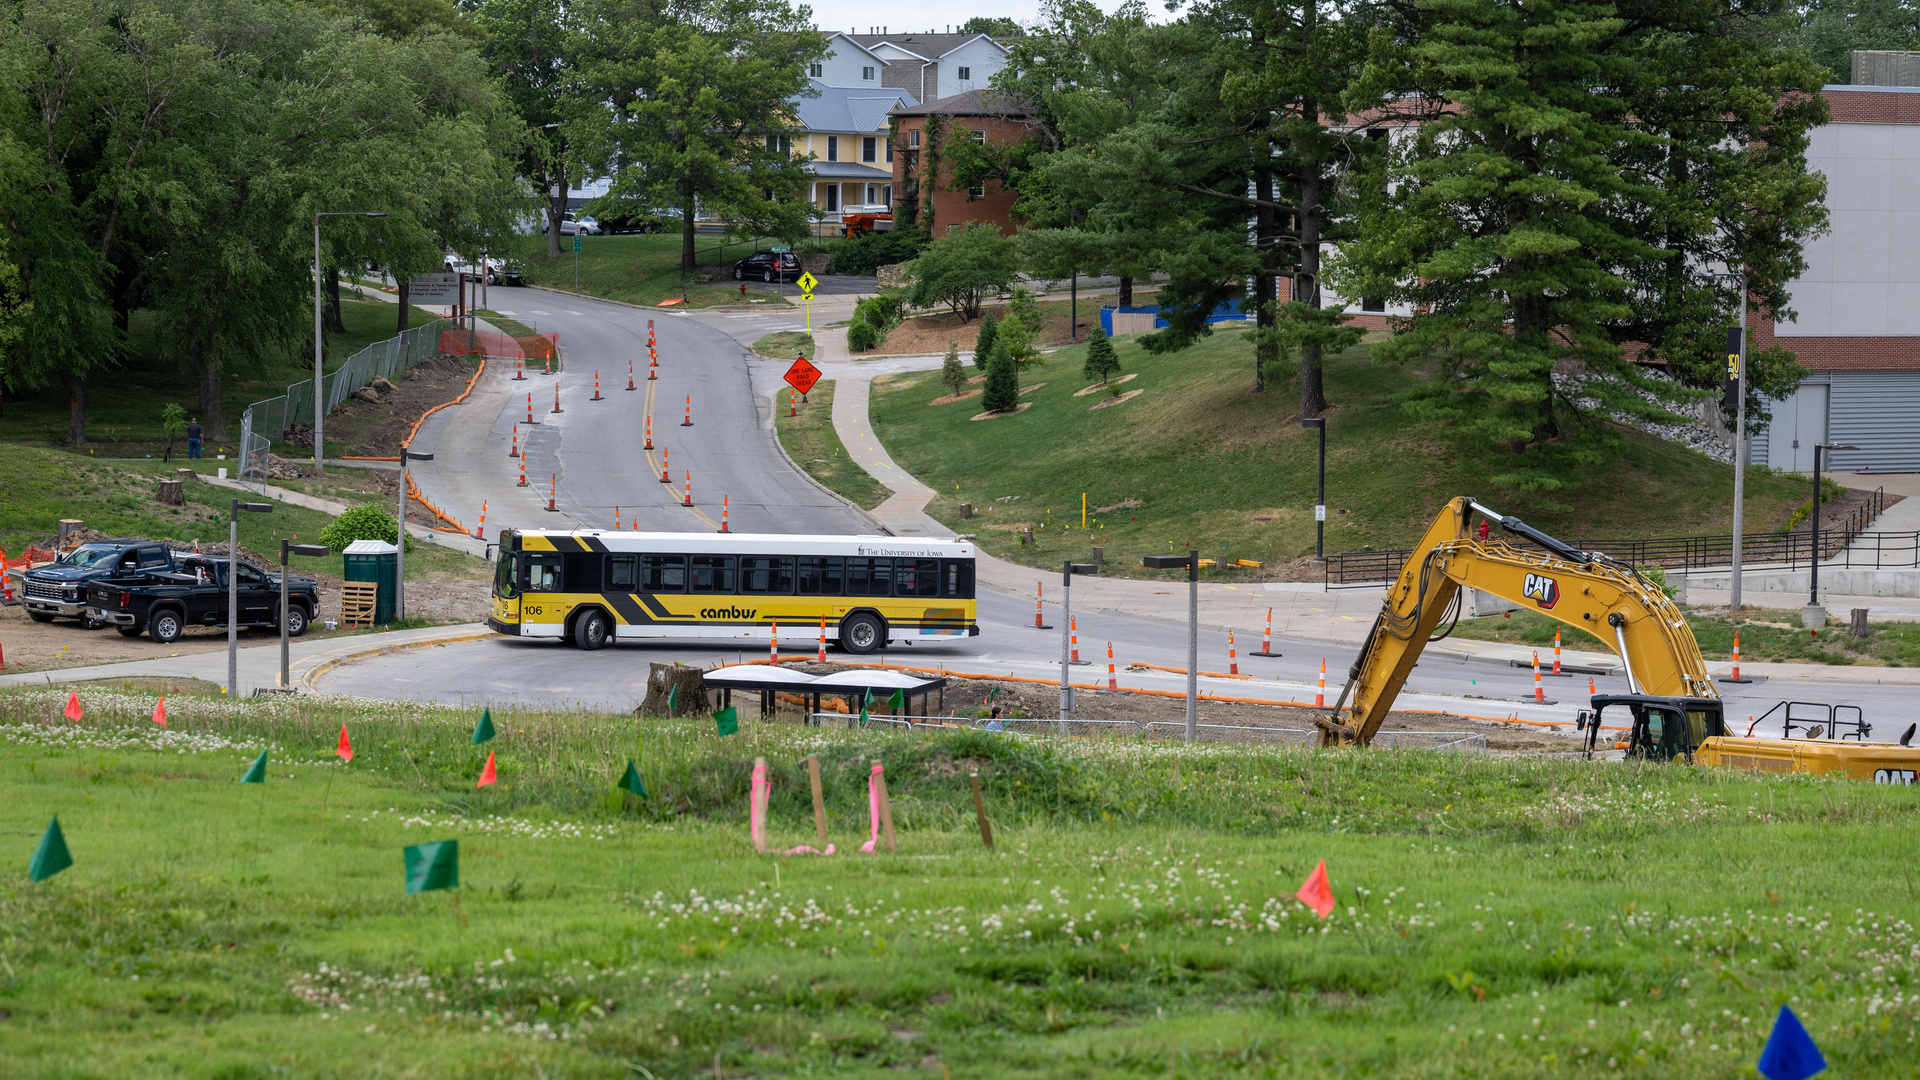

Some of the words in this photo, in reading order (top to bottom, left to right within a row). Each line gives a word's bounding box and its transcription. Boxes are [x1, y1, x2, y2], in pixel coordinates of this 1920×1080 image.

[1728, 354, 1739, 380] 150
[1523, 573, 1553, 602] CAT
[524, 606, 543, 615] 106
[700, 605, 757, 619] cambus
